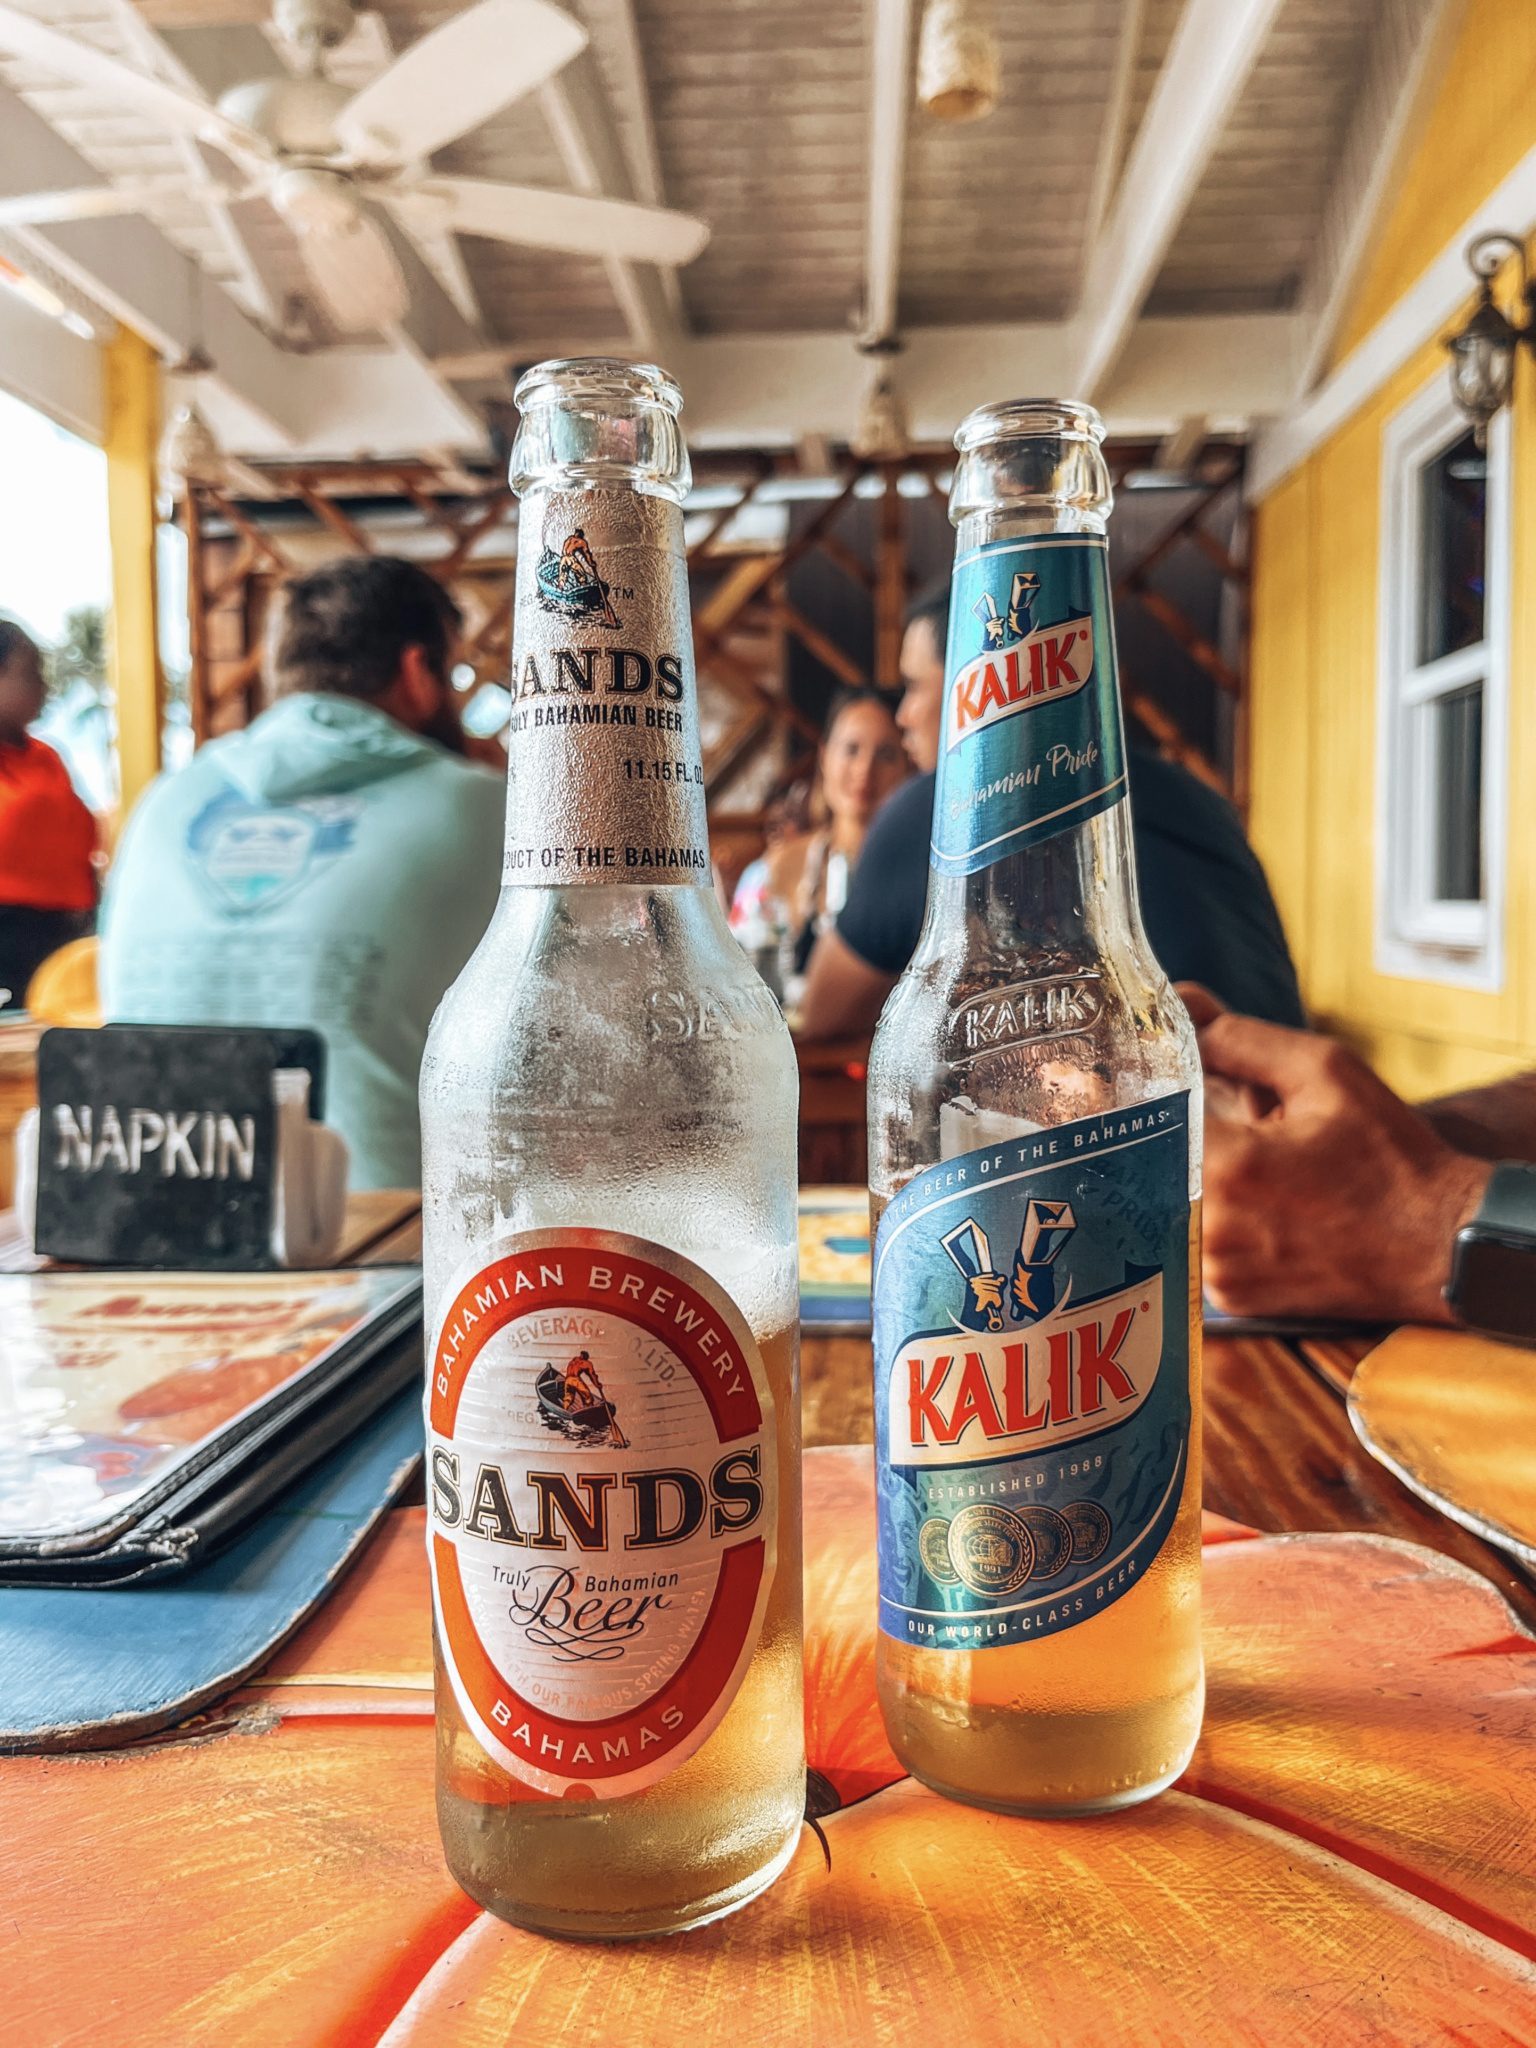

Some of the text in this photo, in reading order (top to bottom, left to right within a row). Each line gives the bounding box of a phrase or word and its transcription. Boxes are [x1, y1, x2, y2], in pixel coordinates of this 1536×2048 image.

[613, 587, 634, 600] TM
[956, 632, 1081, 730] KALIK
[535, 703, 637, 727] BAHAMIAN
[645, 705, 683, 732] BEER
[623, 759, 671, 780] 11.15
[1046, 740, 1098, 778] Pride
[504, 847, 706, 869] DUCT OF THE BAHAMAS
[966, 986, 1097, 1049] KALIK
[53, 1103, 255, 1182] NAPKIN
[894, 1110, 1167, 1218] THE BEER OF THE BAHAMAS
[436, 1263, 746, 1399] BAHAMIAN BREWERY
[907, 1306, 1139, 1447] KALIK
[431, 1444, 765, 1552] SANDS
[928, 1454, 1104, 1499] ESTABLISHED 1988
[492, 1565, 679, 1593] Truly Bahamian
[908, 1560, 1137, 1637] OUR WORLD-CLASS BEER
[509, 1564, 673, 1662] Beer
[532, 1682, 561, 1704] OUR
[635, 1644, 682, 1690] SPRING
[490, 1699, 685, 1764] BAHAMAS
